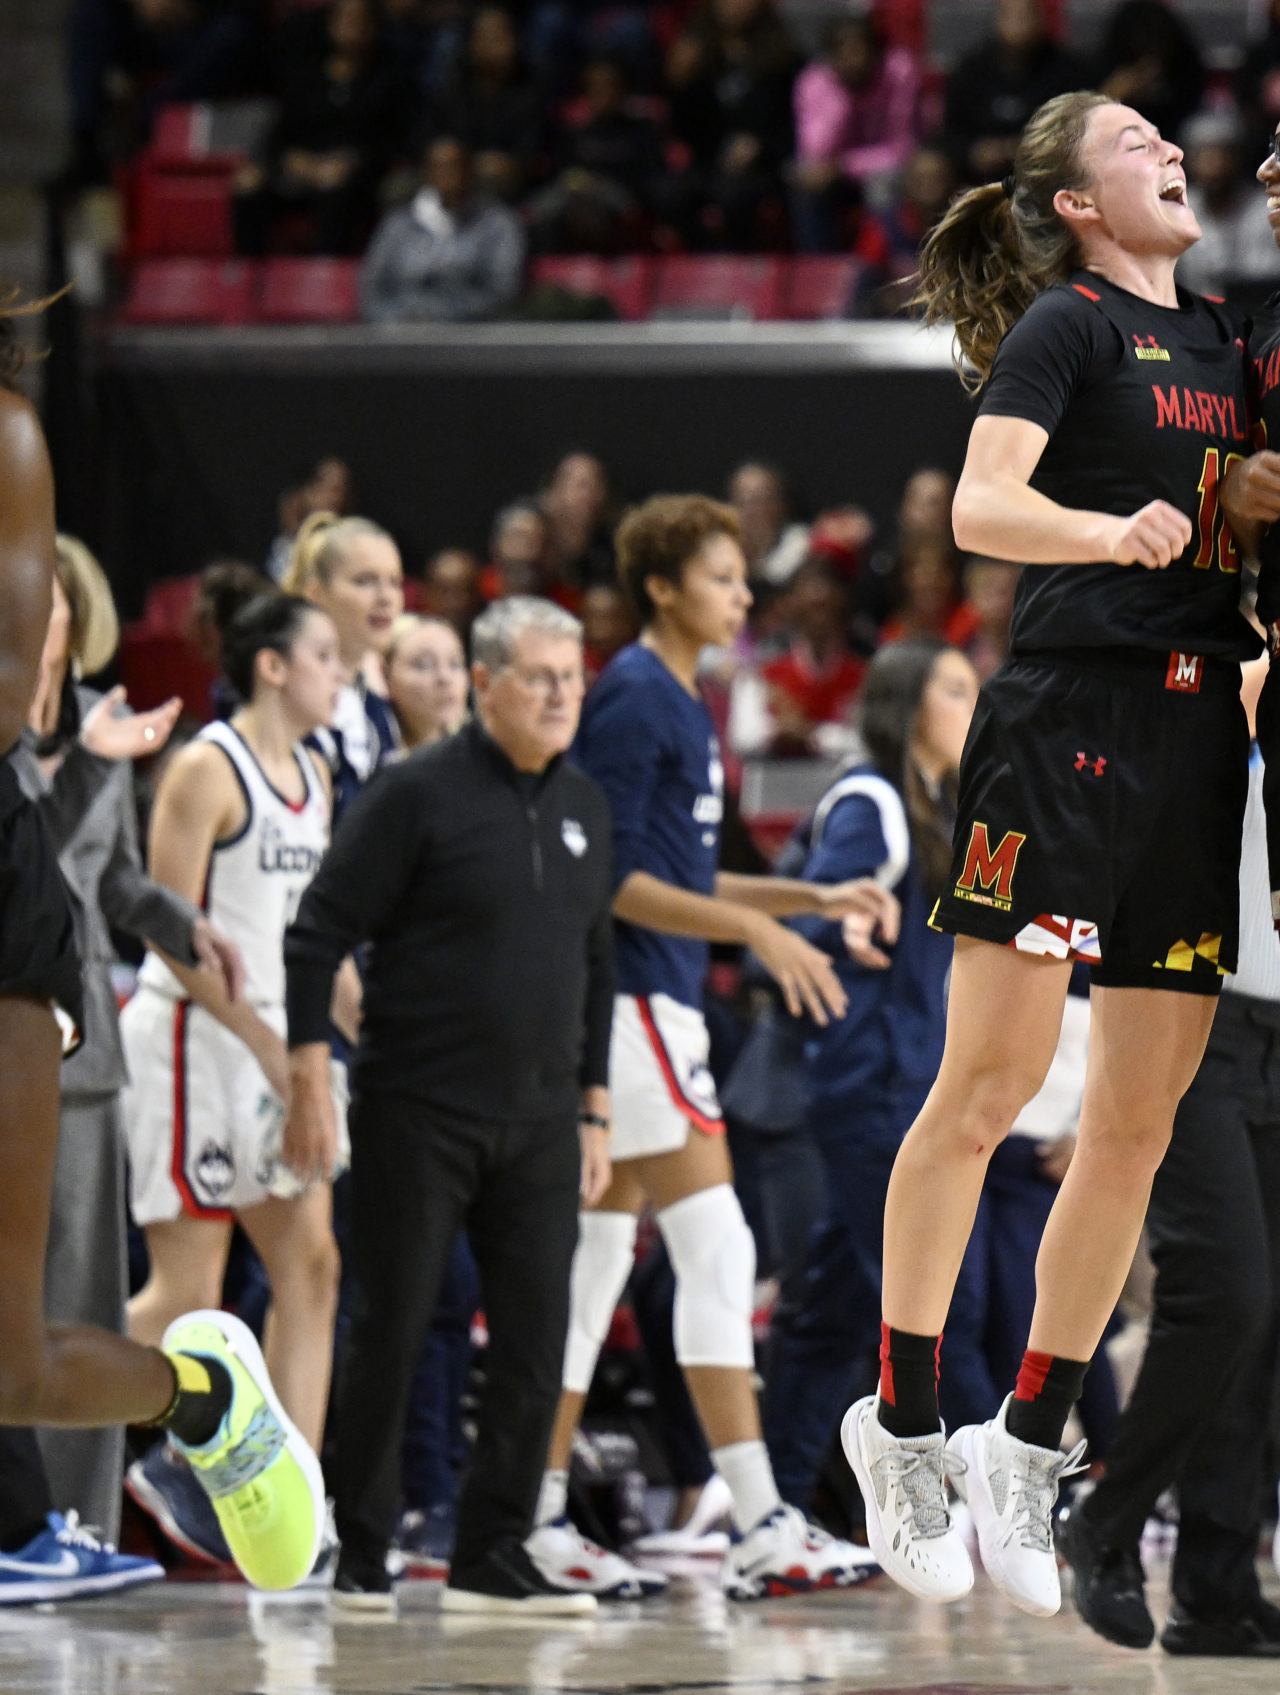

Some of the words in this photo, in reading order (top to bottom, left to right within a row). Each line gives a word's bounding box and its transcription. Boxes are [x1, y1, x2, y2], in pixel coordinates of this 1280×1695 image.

[1151, 384, 1247, 440] MARYL
[1174, 652, 1199, 684] M
[258, 844, 322, 874] UCON
[956, 820, 1027, 902] M
